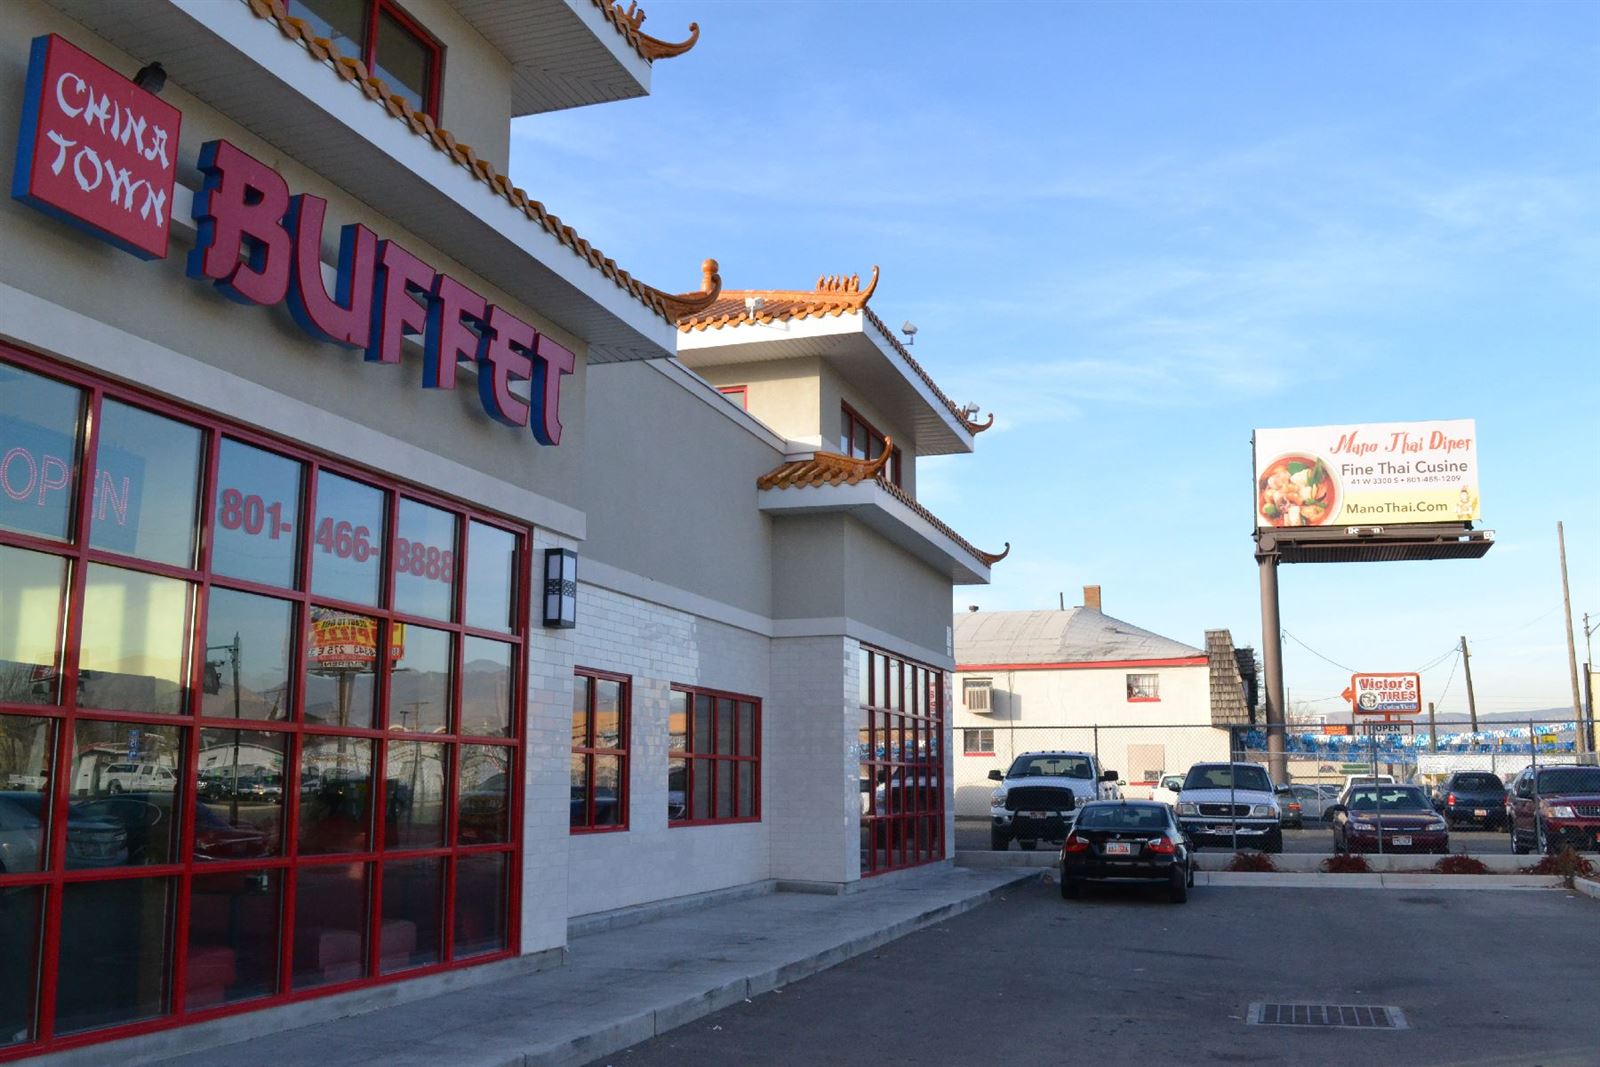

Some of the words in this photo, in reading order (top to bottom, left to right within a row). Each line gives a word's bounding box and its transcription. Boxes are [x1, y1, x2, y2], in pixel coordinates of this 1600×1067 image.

[55, 72, 170, 170] CHINA
[46, 130, 167, 227] TOWN
[188, 138, 576, 447] BUFFET
[1384, 431, 1424, 455] Thai
[1341, 463, 1374, 476] Fine
[1377, 460, 1411, 475] Thai
[1415, 459, 1468, 474] Cusine
[0, 446, 130, 526] OPN
[1346, 501, 1448, 514] ManoThai.Com
[396, 537, 454, 584] 8888
[1359, 677, 1415, 691] Victor's
[1378, 690, 1417, 702] TIRES
[1375, 724, 1400, 732] OPEN
